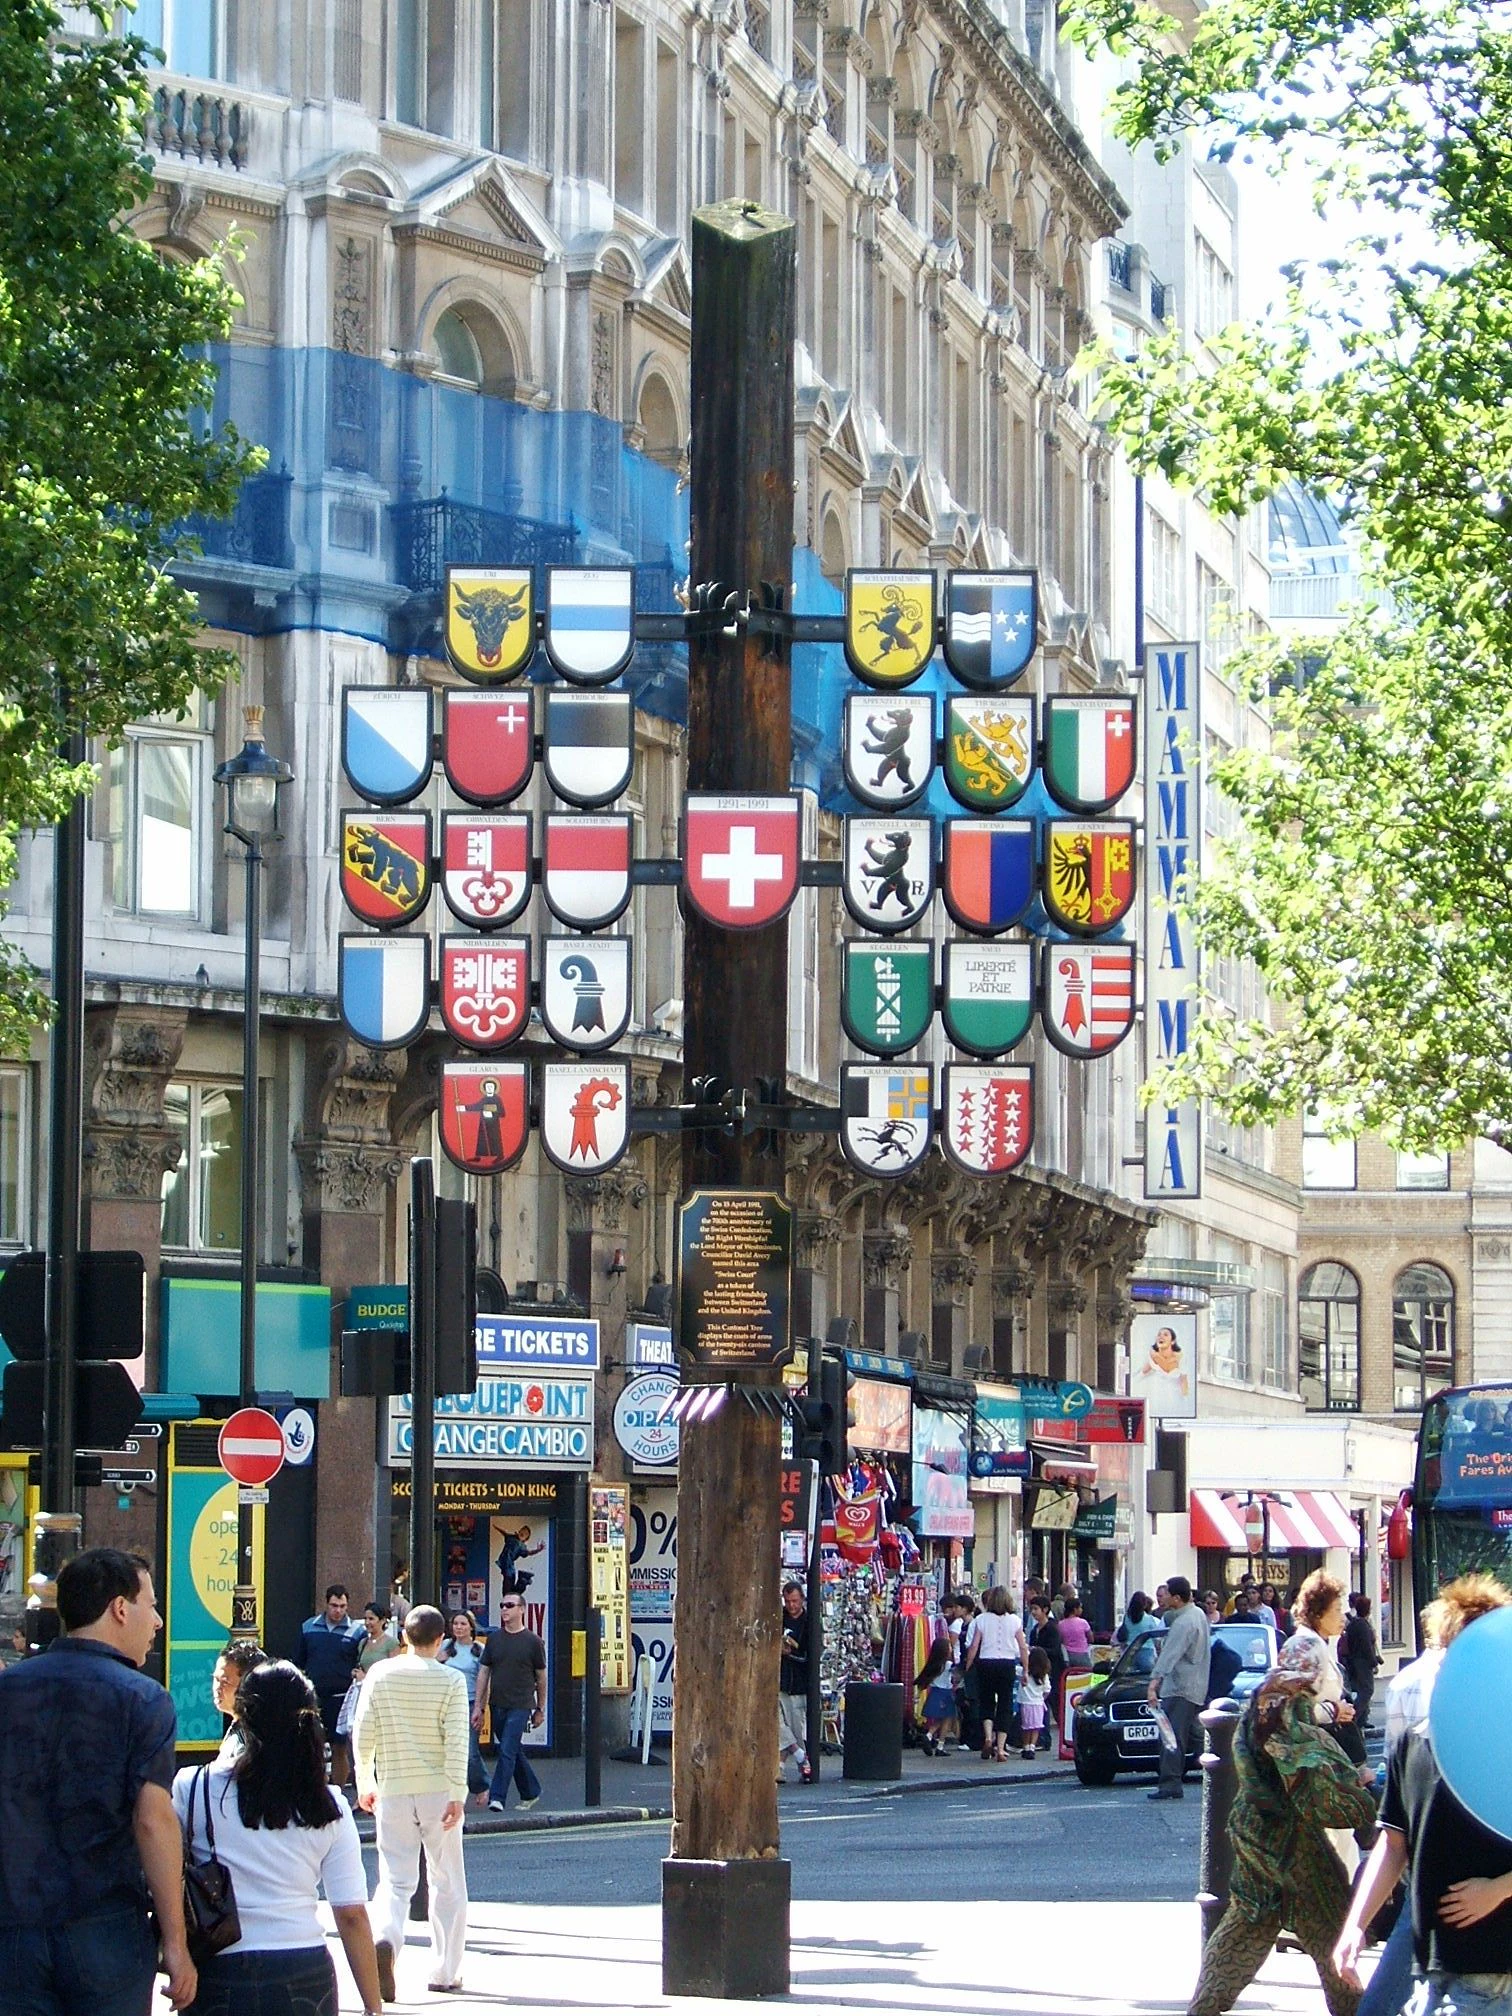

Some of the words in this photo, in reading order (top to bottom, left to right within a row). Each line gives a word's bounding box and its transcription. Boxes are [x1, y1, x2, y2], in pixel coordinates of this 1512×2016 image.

[1155, 651, 1190, 970] MAMMA
[861, 880, 875, 894] V
[965, 960, 1017, 973] LIBERTÉ
[982, 972, 1001, 982] ET
[969, 982, 1012, 993] PATRIE
[712, 1200, 722, 1208] On
[731, 1200, 746, 1209] April
[729, 1217, 764, 1226] anniversary
[715, 1234, 733, 1242] Right
[734, 1234, 768, 1243] Worshipful
[716, 1242, 736, 1251] Mayor
[753, 1252, 771, 1260] Avery
[714, 1290, 735, 1298] lasting
[736, 1290, 768, 1299] friendship
[707, 1323, 721, 1331] This
[721, 1323, 749, 1331] Cantonal
[750, 1323, 764, 1331] Tree
[501, 1328, 589, 1356] TICKETS
[697, 1332, 722, 1340] displays
[624, 1411, 678, 1428] OPE
[398, 1423, 498, 1454] CANGE
[500, 1426, 588, 1456] CAMBIO
[650, 1428, 662, 1439] 24
[632, 1439, 678, 1457] HOURS
[1466, 1453, 1490, 1465] The
[1460, 1464, 1495, 1477] Fares
[442, 1483, 488, 1497] TICKETS
[497, 1483, 526, 1497] LION
[528, 1484, 557, 1498] KING
[903, 1587, 925, 1604] £3.99
[1127, 1727, 1156, 1739] GR04
